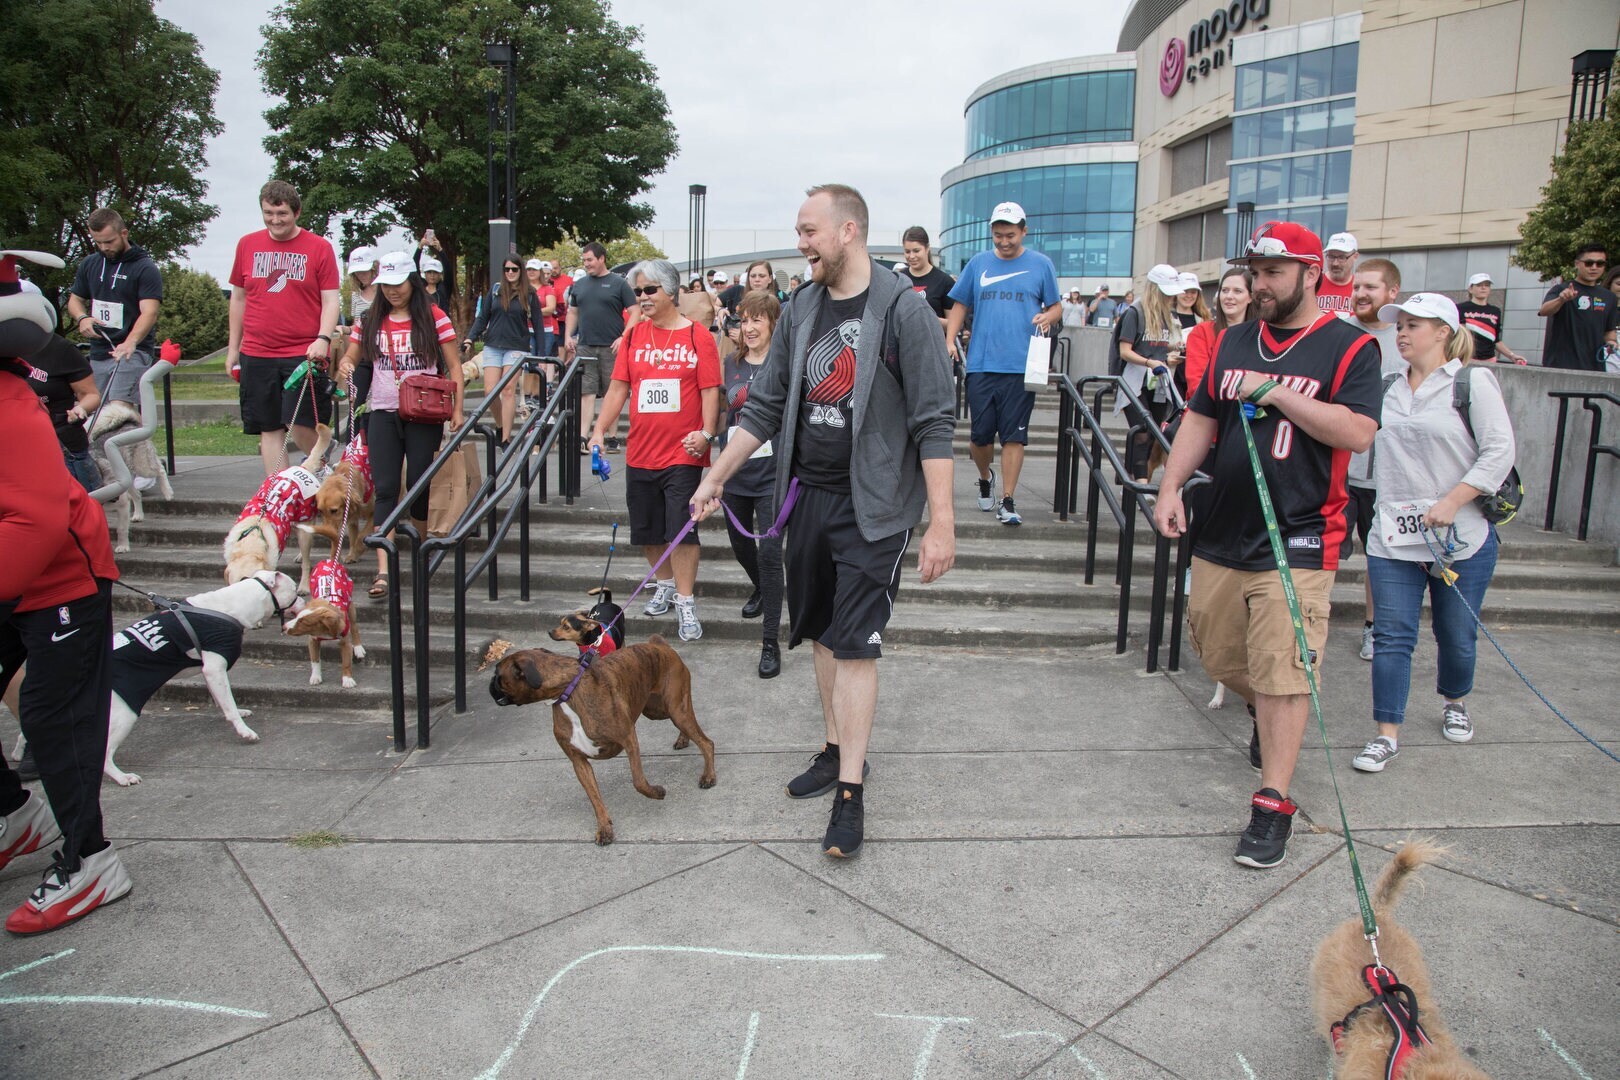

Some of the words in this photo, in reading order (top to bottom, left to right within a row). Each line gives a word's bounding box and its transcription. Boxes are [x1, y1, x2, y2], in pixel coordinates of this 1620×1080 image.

[1187, 0, 1270, 57] moda
[980, 290, 997, 300] JUST
[1000, 291, 1012, 300] DO
[1317, 295, 1353, 312] ORTLA
[100, 310, 110, 321] 18
[634, 343, 698, 368] ripcity
[646, 389, 669, 404] 308
[1271, 419, 1293, 459] 0
[293, 470, 313, 487] 280
[1294, 538, 1308, 546] NBA
[1253, 797, 1280, 808] JORDAN
